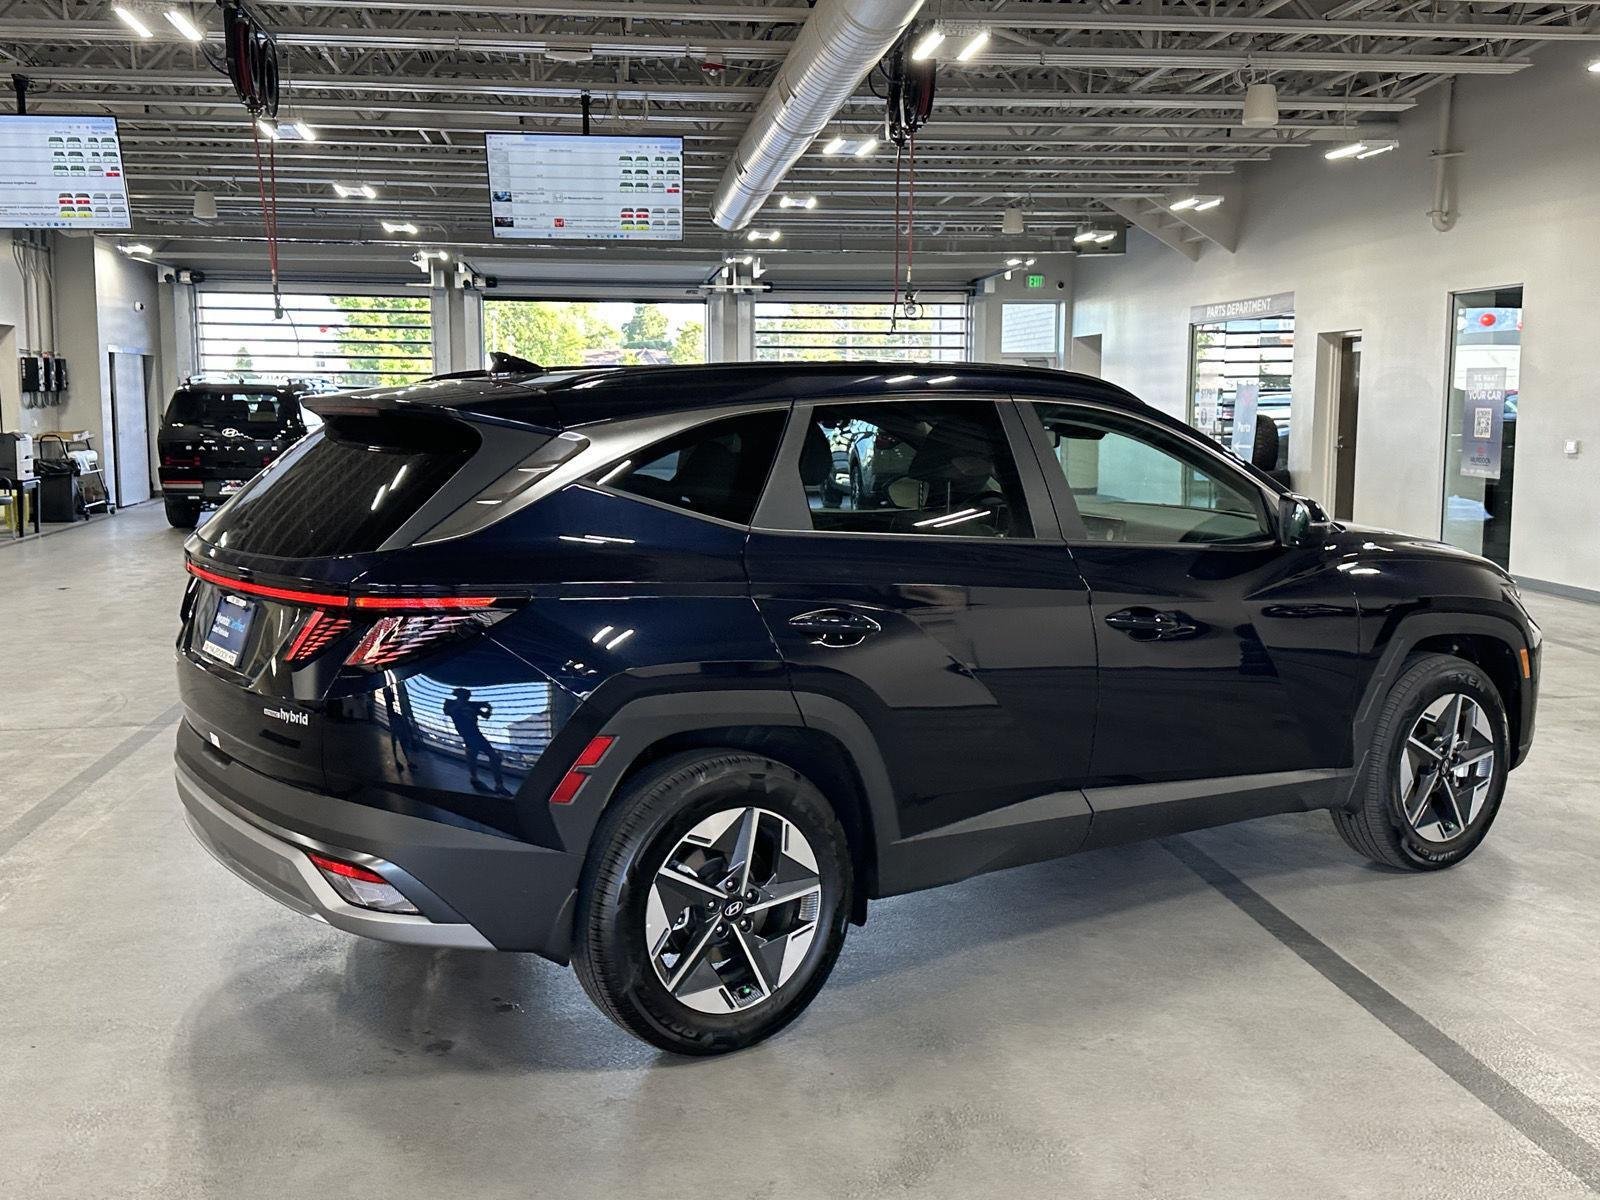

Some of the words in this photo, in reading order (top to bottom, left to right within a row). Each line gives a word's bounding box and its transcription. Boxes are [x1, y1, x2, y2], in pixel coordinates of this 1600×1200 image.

[1206, 304, 1226, 318] PARTS
[1226, 298, 1271, 316] DEPARTMENT
[1468, 390, 1487, 401] YOUR
[1487, 390, 1502, 401] CAR
[280, 708, 308, 726] hybrid
